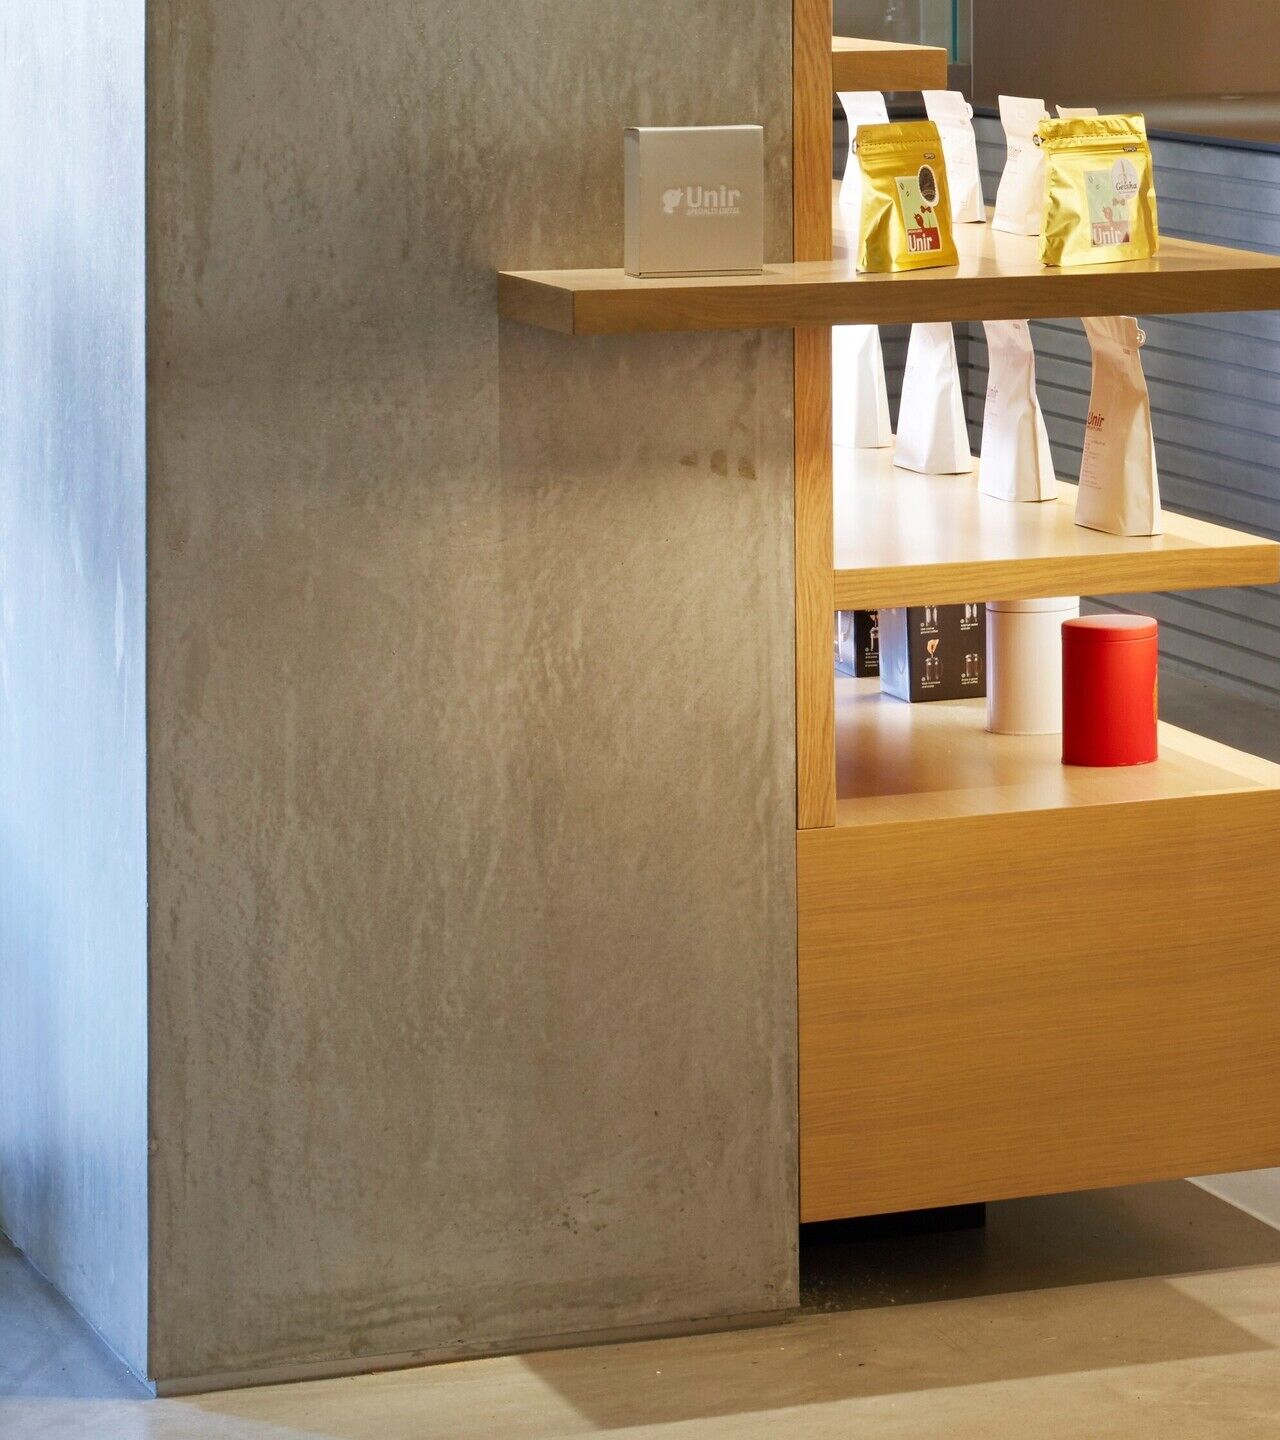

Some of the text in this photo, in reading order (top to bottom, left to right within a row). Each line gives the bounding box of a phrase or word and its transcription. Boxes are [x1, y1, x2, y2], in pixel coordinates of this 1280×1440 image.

[686, 185, 740, 208] Unir
[908, 232, 933, 252] Unir
[1093, 226, 1122, 245] Unir
[1087, 411, 1105, 428] Unir
